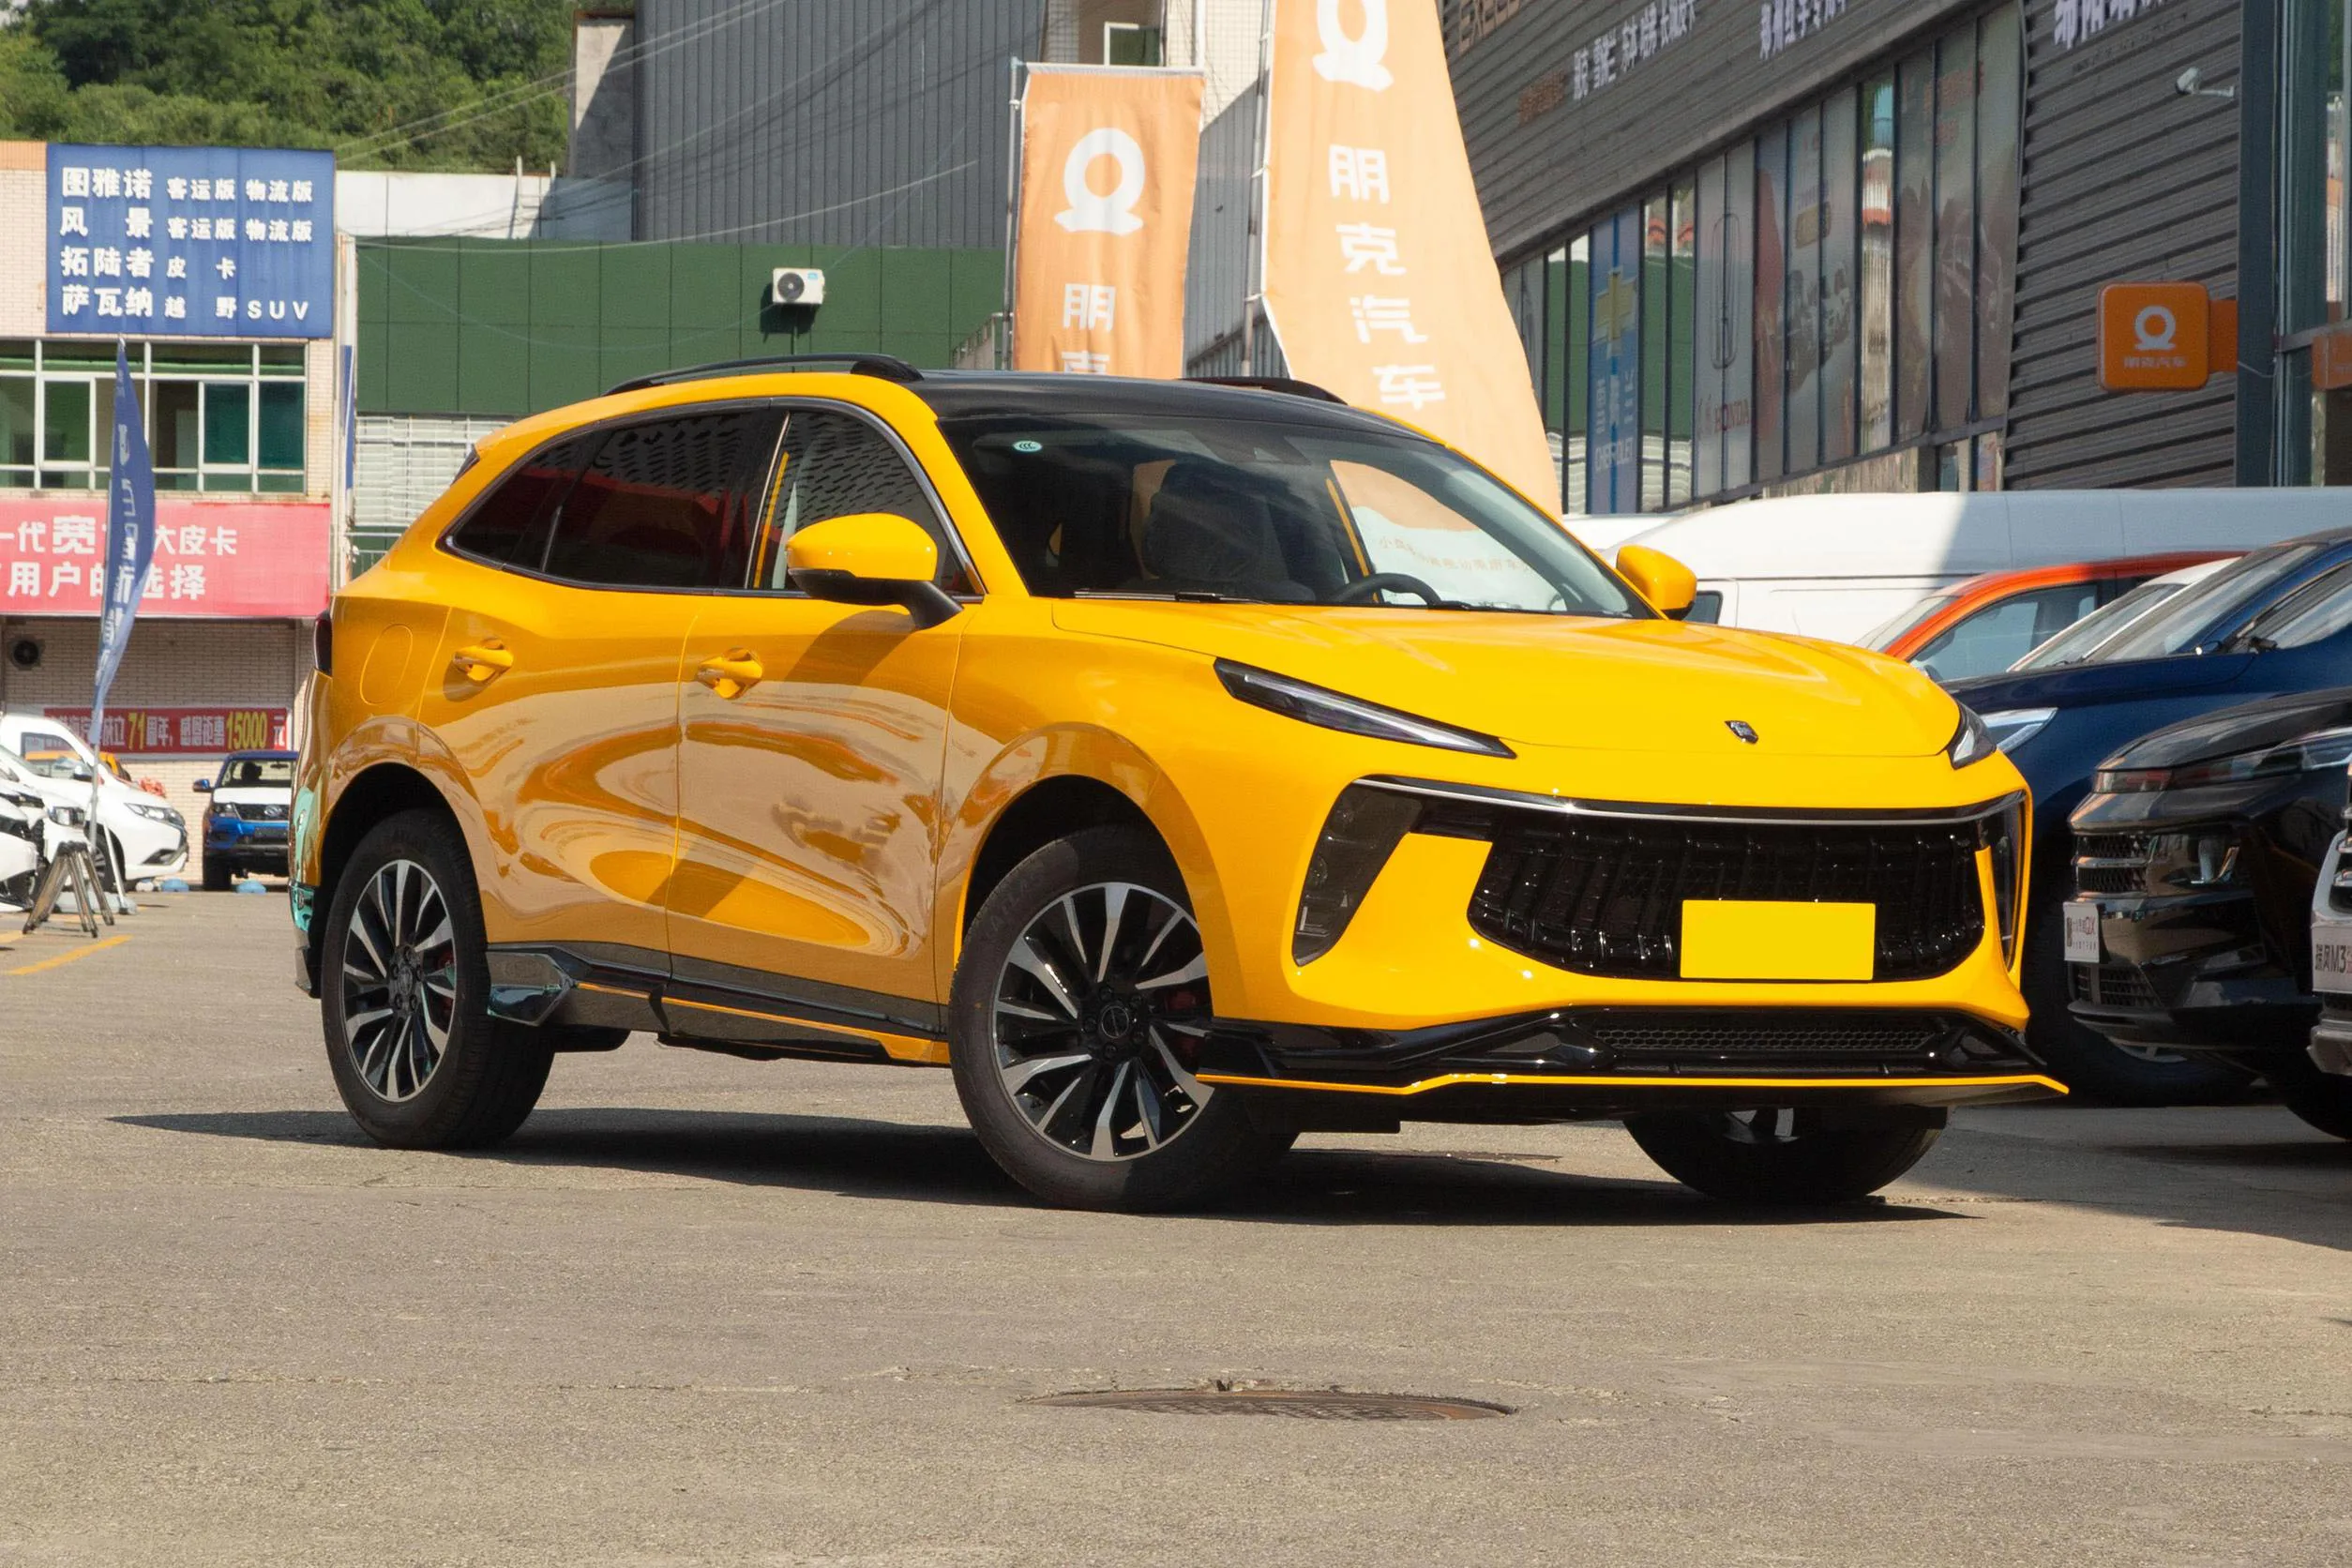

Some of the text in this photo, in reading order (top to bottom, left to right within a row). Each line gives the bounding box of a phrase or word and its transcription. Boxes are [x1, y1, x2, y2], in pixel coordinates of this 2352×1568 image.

[166, 176, 235, 202] 客运版
[246, 179, 312, 203] 物流版
[167, 218, 235, 241] 客运版
[246, 219, 312, 242] 物流版
[60, 246, 154, 279] 拓陆者
[1328, 143, 1446, 411] 朋克汽车
[62, 283, 154, 318] 萨瓦纳
[248, 299, 309, 321] SUV
[0, 515, 237, 556] 一代宽大皮卡
